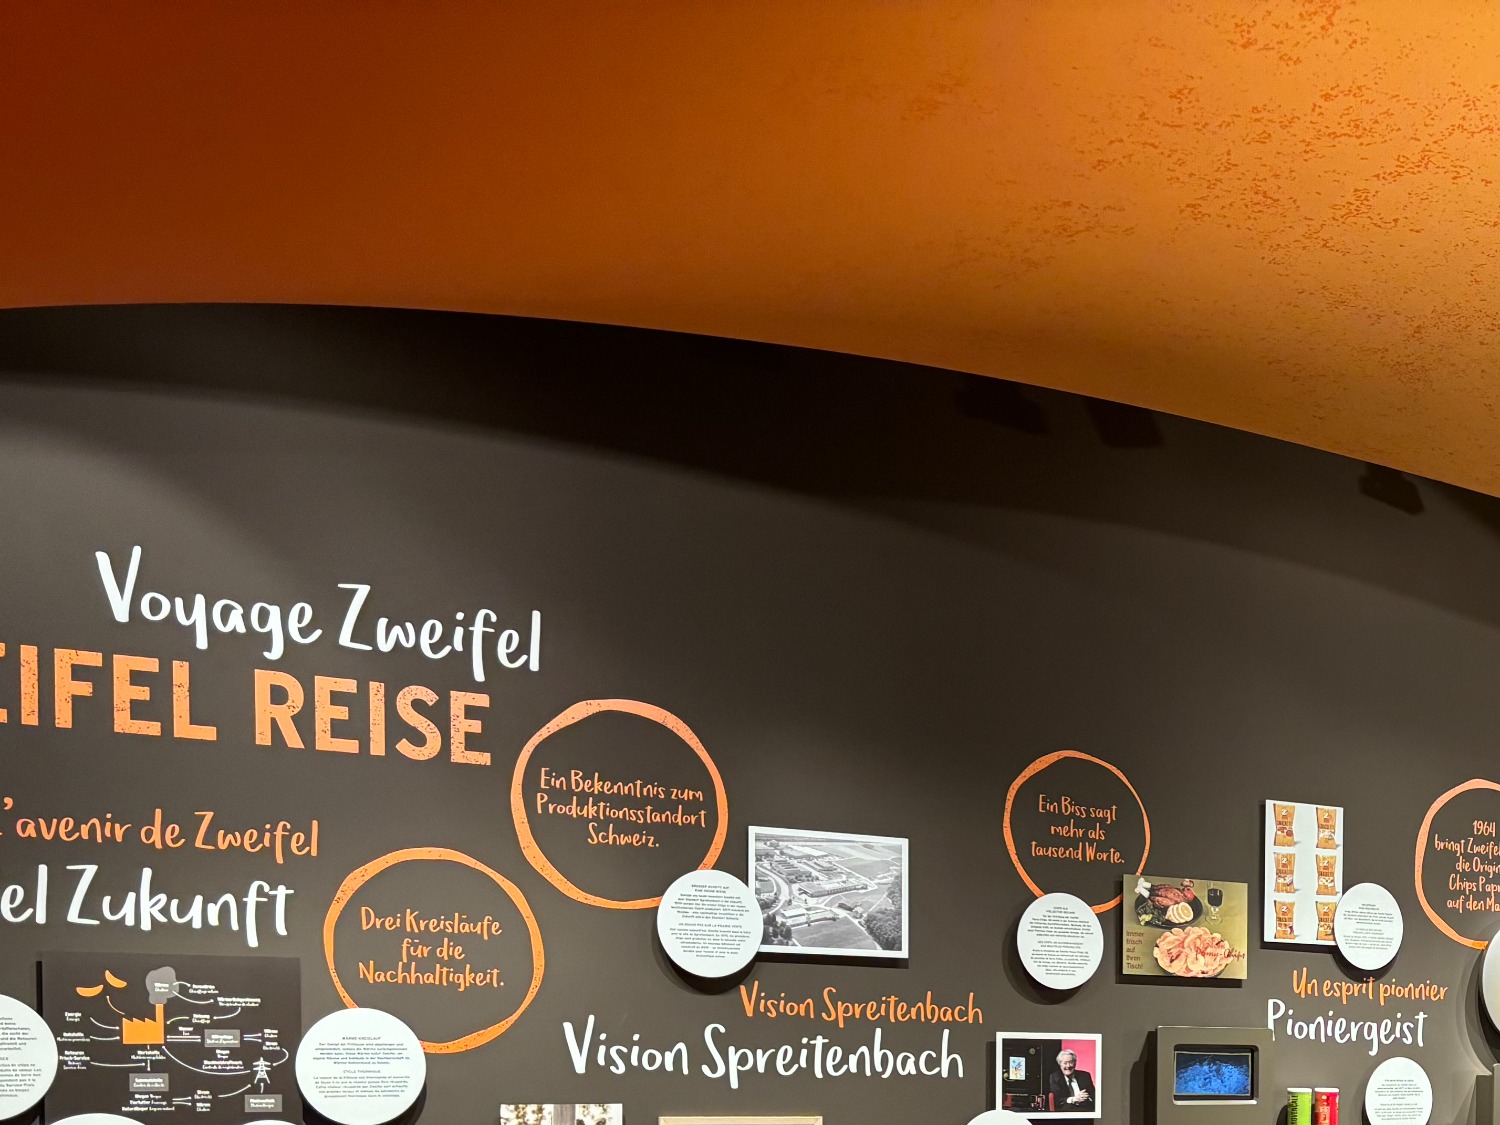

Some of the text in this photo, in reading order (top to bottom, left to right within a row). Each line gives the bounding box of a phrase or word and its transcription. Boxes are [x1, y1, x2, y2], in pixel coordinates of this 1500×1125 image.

[95, 546, 542, 682] Voyage Zweifel
[0, 642, 492, 766] IFEL REISE
[540, 768, 703, 801] Ein Bekenntnis zum
[536, 793, 707, 828] Produktionsstandort
[1038, 794, 1118, 823] Ein Biss sagt
[140, 808, 187, 850] de
[194, 811, 319, 864] Zweifel
[588, 822, 660, 848] Schweiz.
[1050, 822, 1106, 841] mehr als
[1472, 820, 1496, 837] 1964
[1031, 841, 1125, 864] tausend Worte.
[1434, 834, 1466, 857] bringt
[1456, 856, 1471, 872] die
[1449, 874, 1477, 892] Chips
[66, 864, 295, 948] Zukunft
[1447, 897, 1465, 913] auf
[1466, 895, 1484, 911] den
[361, 907, 503, 937] Drei Kreisläufe
[401, 937, 466, 963] für die
[358, 961, 505, 992] Nachhaltigkeit.
[1292, 967, 1449, 1006] Un esprit pionnier
[739, 980, 983, 1028] Vision Spreitenbach
[1267, 998, 1428, 1056] Pioniergeist
[562, 1014, 964, 1089] Vision Spreitenbach
